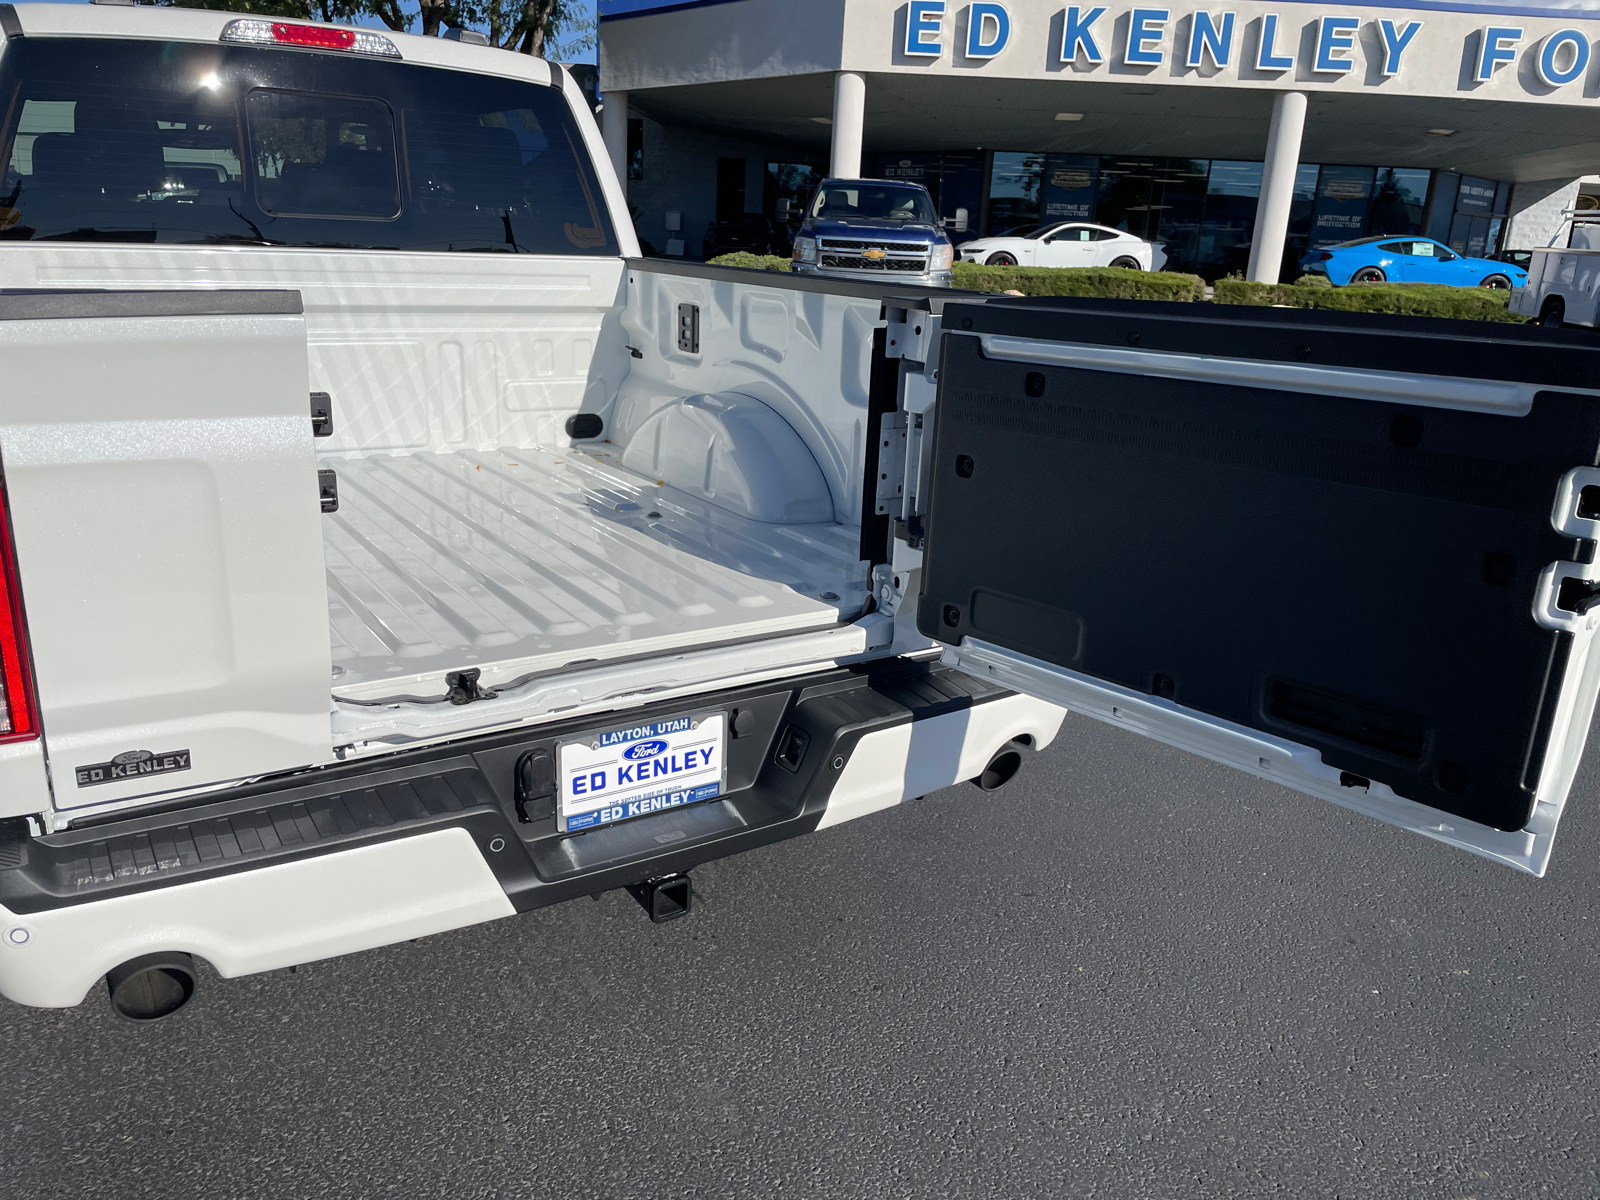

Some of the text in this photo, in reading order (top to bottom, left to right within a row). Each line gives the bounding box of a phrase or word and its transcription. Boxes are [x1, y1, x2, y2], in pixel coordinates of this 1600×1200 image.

[904, 0, 1012, 59] ED
[1060, 4, 1426, 77] KENLEY
[602, 718, 689, 745] LAYTON, UTAH
[121, 753, 143, 763] Ford
[631, 742, 660, 759] Ford
[77, 754, 188, 783] ED KENLEY
[572, 746, 714, 796] ED KENLEY
[600, 790, 690, 823] ED KENLEY
[620, 794, 642, 804] SOFTER
[642, 790, 655, 799] SIDE
[664, 785, 682, 793] TOUCH
